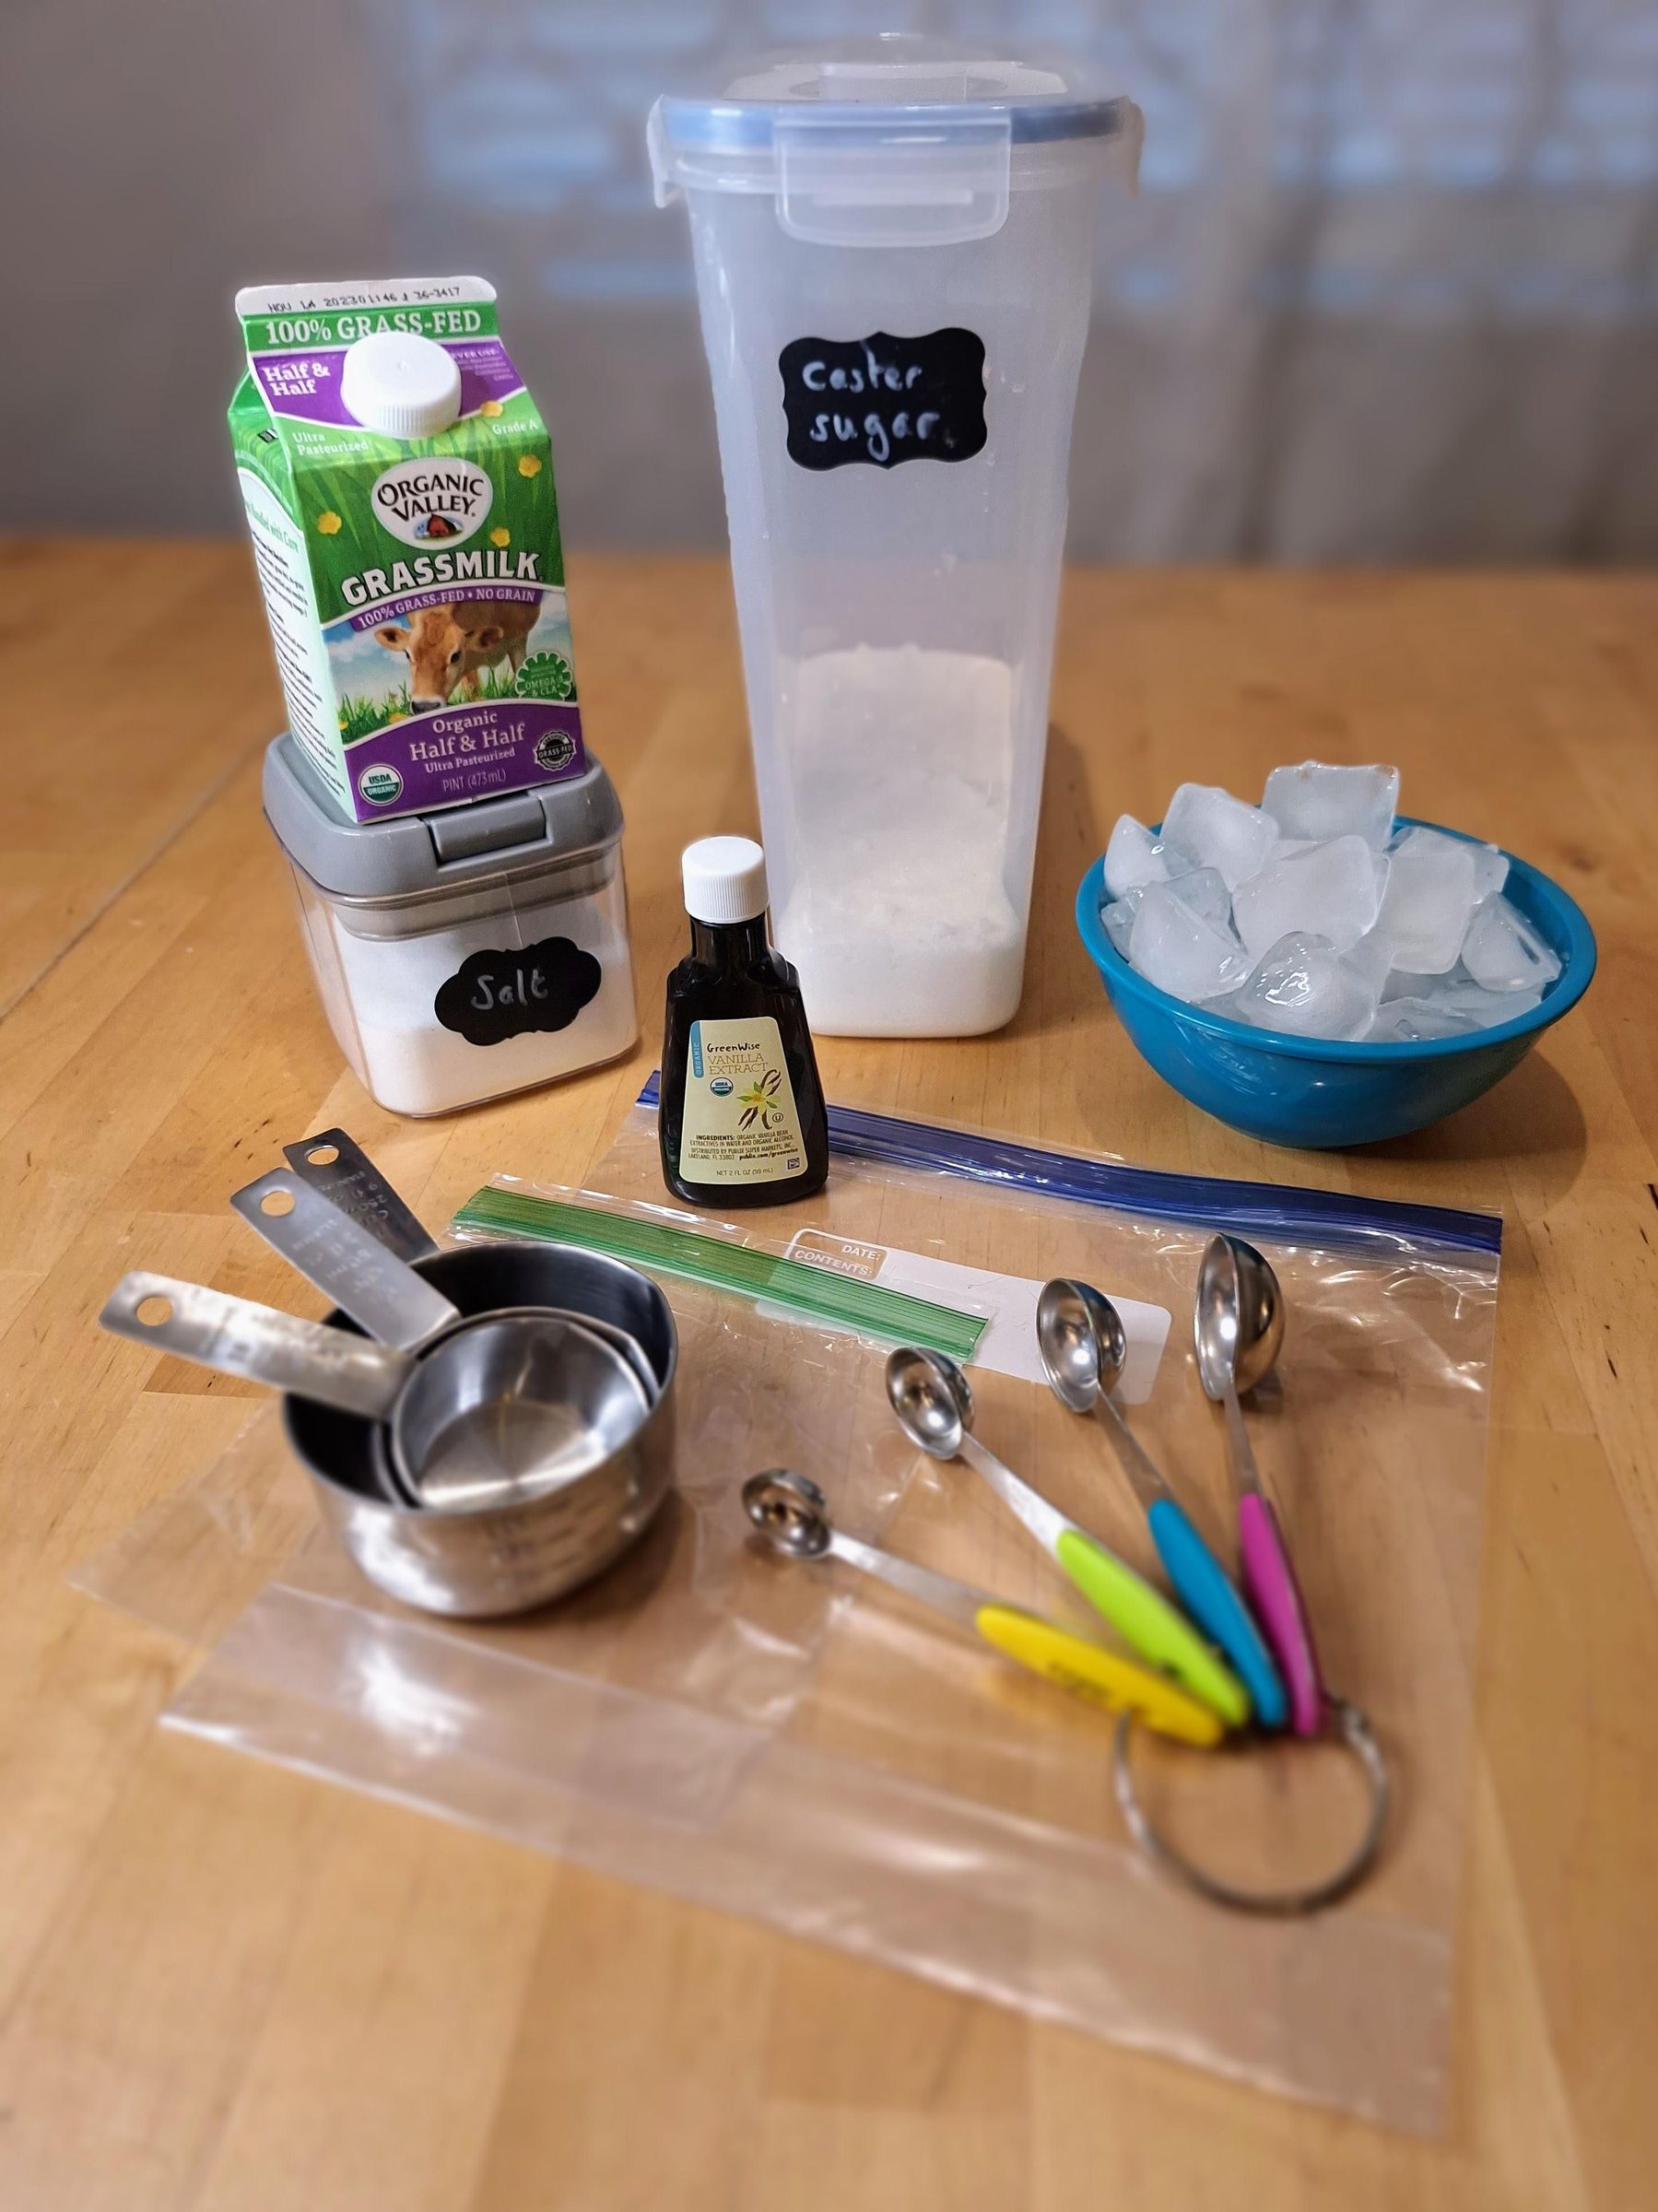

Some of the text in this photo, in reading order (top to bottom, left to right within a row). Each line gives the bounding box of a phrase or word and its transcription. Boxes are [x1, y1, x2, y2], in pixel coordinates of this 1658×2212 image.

[266, 310, 481, 345] 100% GRASS-FED
[261, 360, 331, 382] Half &
[269, 379, 317, 396] Half
[292, 431, 325, 442] Ultra
[492, 418, 538, 435] Grade A
[809, 412, 940, 462] sugar
[297, 441, 369, 455] Pasteurized
[378, 474, 484, 507] ORGANIC
[392, 495, 476, 522] VALLEY
[341, 549, 540, 607] GRASSMILK
[358, 588, 535, 629] 100% GRASS-FED NO GRAIN
[433, 711, 498, 734] Organic
[410, 723, 525, 761] Half & Half
[426, 747, 515, 773] Ultra Pasteurized
[368, 784, 396, 795] ORGANIC
[369, 774, 393, 784] USDA
[443, 776, 464, 792] PINT
[471, 969, 548, 1010] Salt
[707, 1042, 760, 1053] GreenWise
[708, 1053, 764, 1065] VANILLA
[709, 1062, 768, 1075] EXTRACT
[795, 1250, 872, 1276] CONTENTS:
[841, 1245, 881, 1260] DATE:
